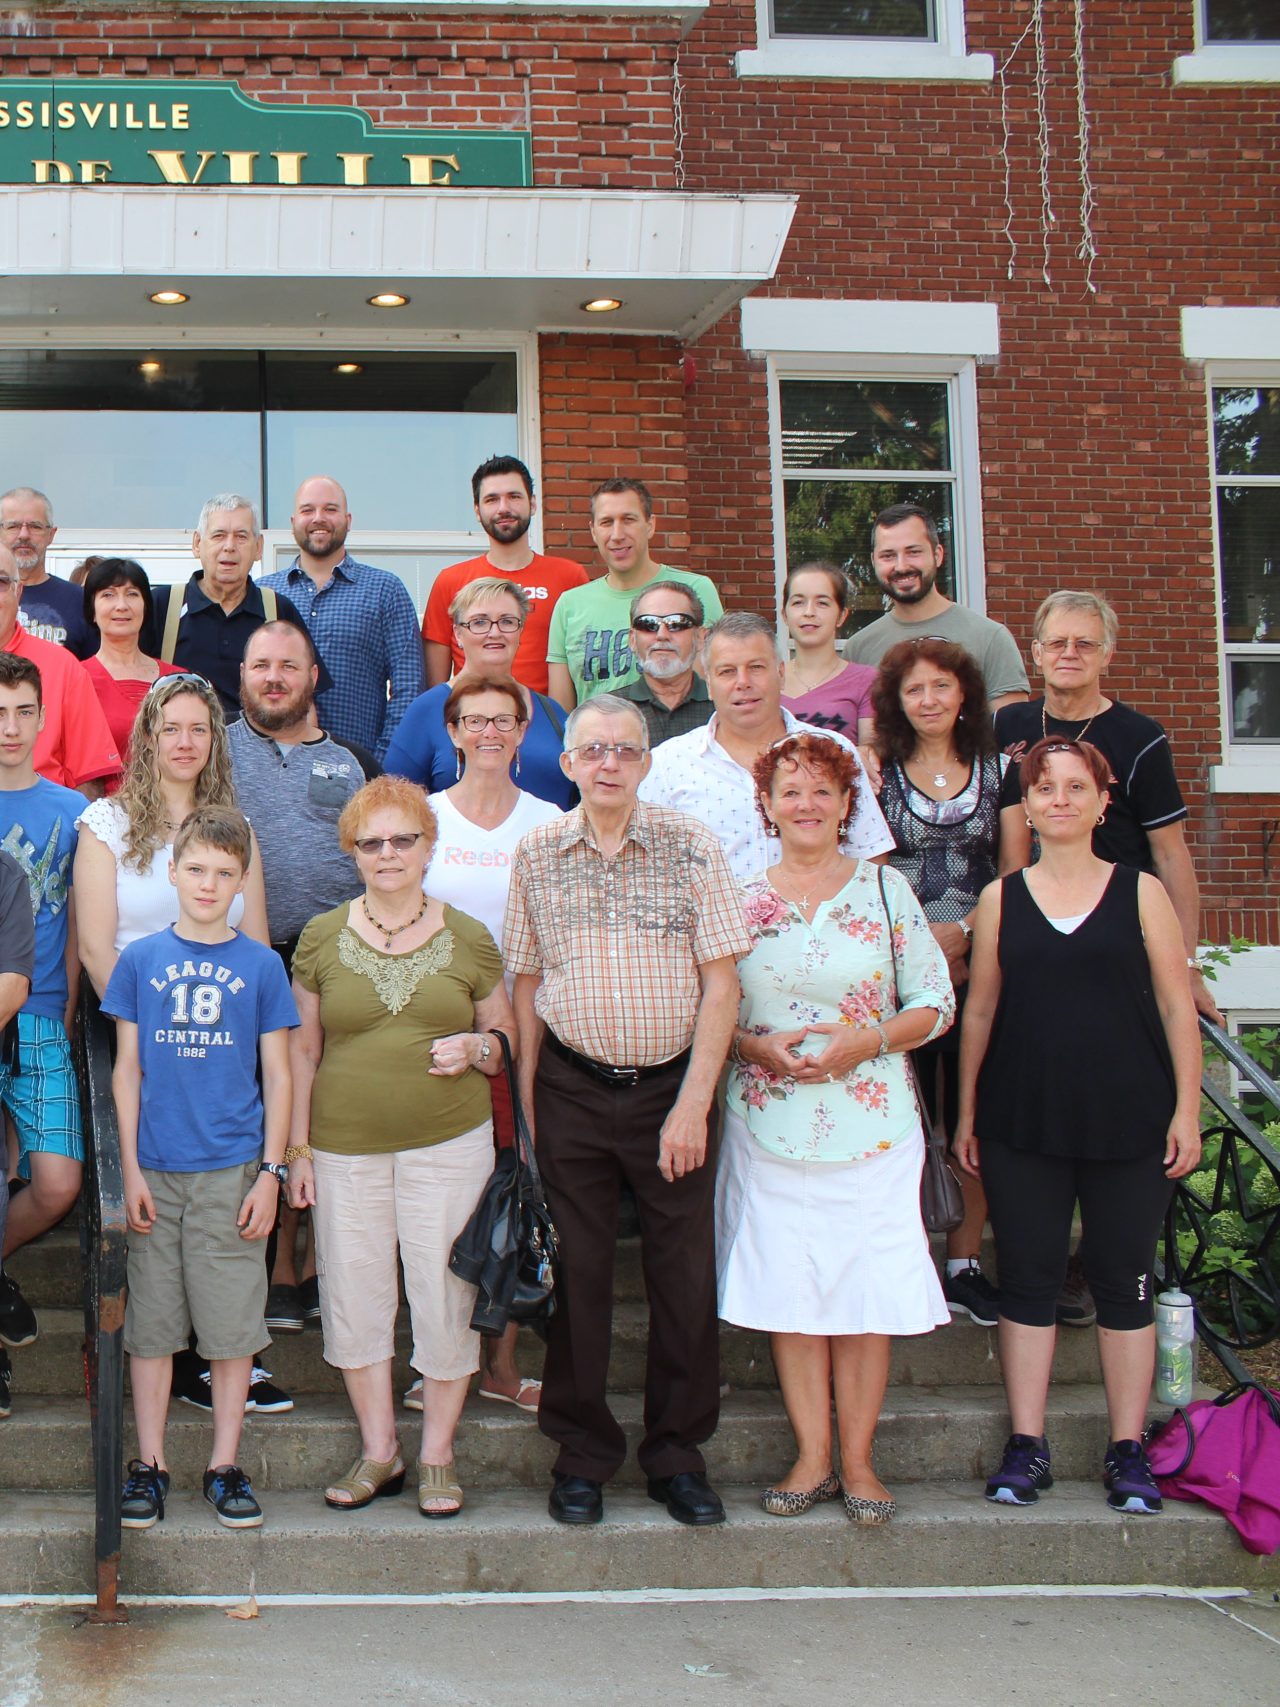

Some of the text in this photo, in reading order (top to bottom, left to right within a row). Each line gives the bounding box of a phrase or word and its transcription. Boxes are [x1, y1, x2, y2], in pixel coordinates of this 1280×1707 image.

[443, 846, 512, 867] Reeb
[150, 961, 245, 995] LEAGUE
[171, 984, 222, 1025] 18
[155, 1029, 233, 1045] CENTRAL
